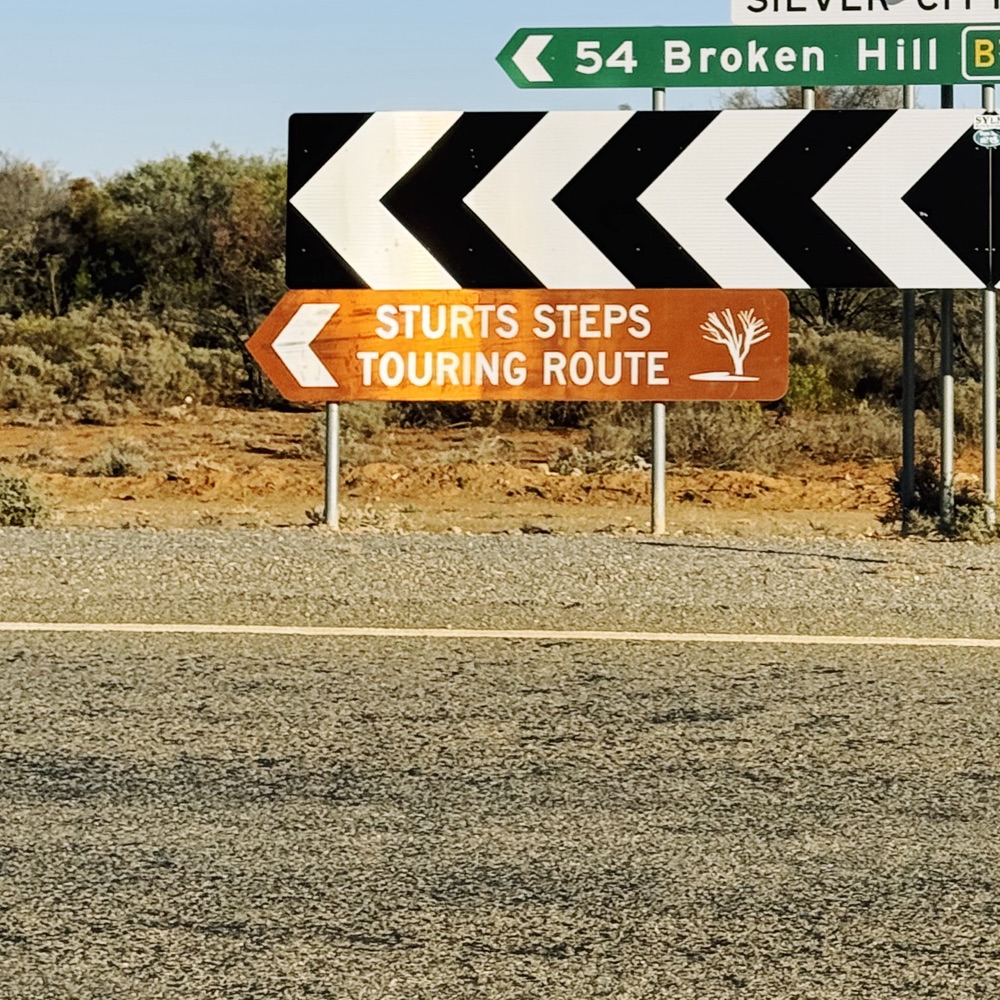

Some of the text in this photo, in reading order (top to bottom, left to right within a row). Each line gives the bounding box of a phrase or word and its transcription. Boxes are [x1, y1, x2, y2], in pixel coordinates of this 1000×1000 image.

[575, 37, 937, 75] 54 Broken Hill
[375, 303, 652, 339] STURTS STEPS
[356, 351, 670, 386] TOURING ROUTE
